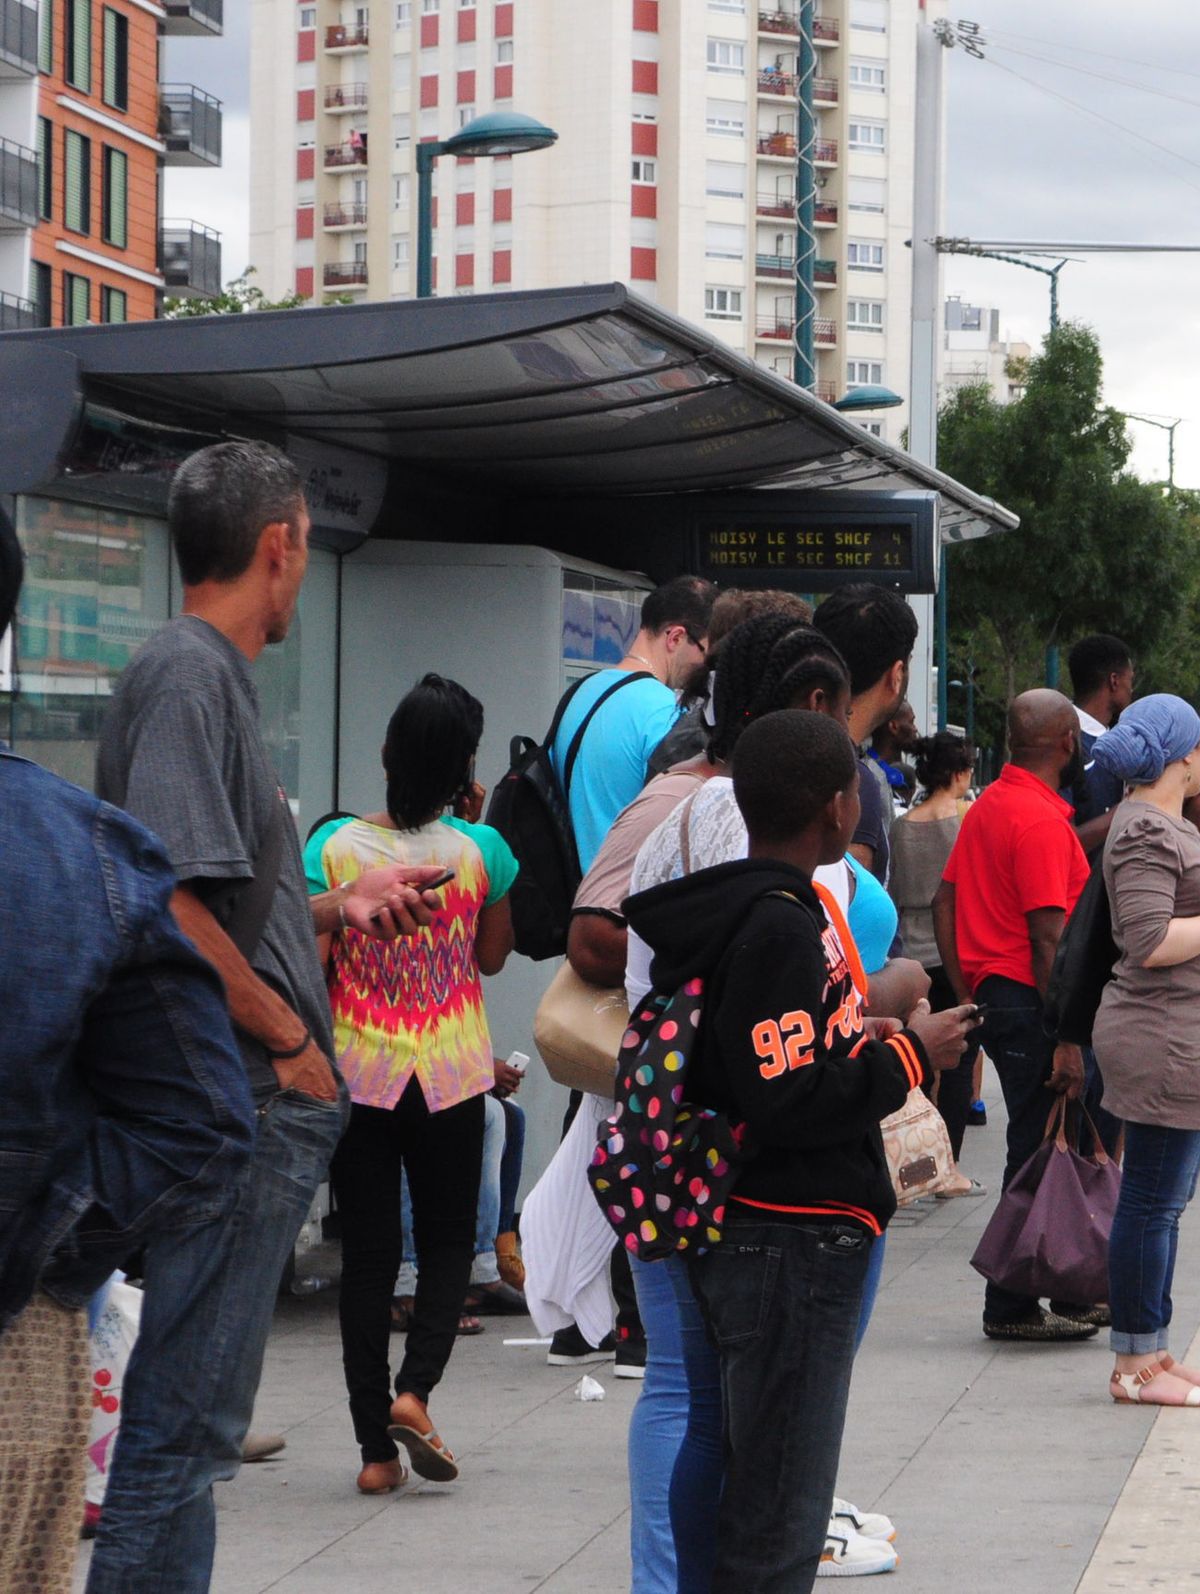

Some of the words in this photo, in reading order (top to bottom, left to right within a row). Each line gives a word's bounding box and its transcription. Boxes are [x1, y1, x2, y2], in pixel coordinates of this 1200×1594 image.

[710, 532, 756, 545] NOISY
[767, 532, 785, 545] LE
[797, 532, 824, 545] SEC
[710, 552, 757, 565] NOISY
[767, 552, 785, 565] LE
[797, 552, 824, 565] SEC
[883, 552, 901, 565] 11
[752, 1009, 816, 1080] 92
